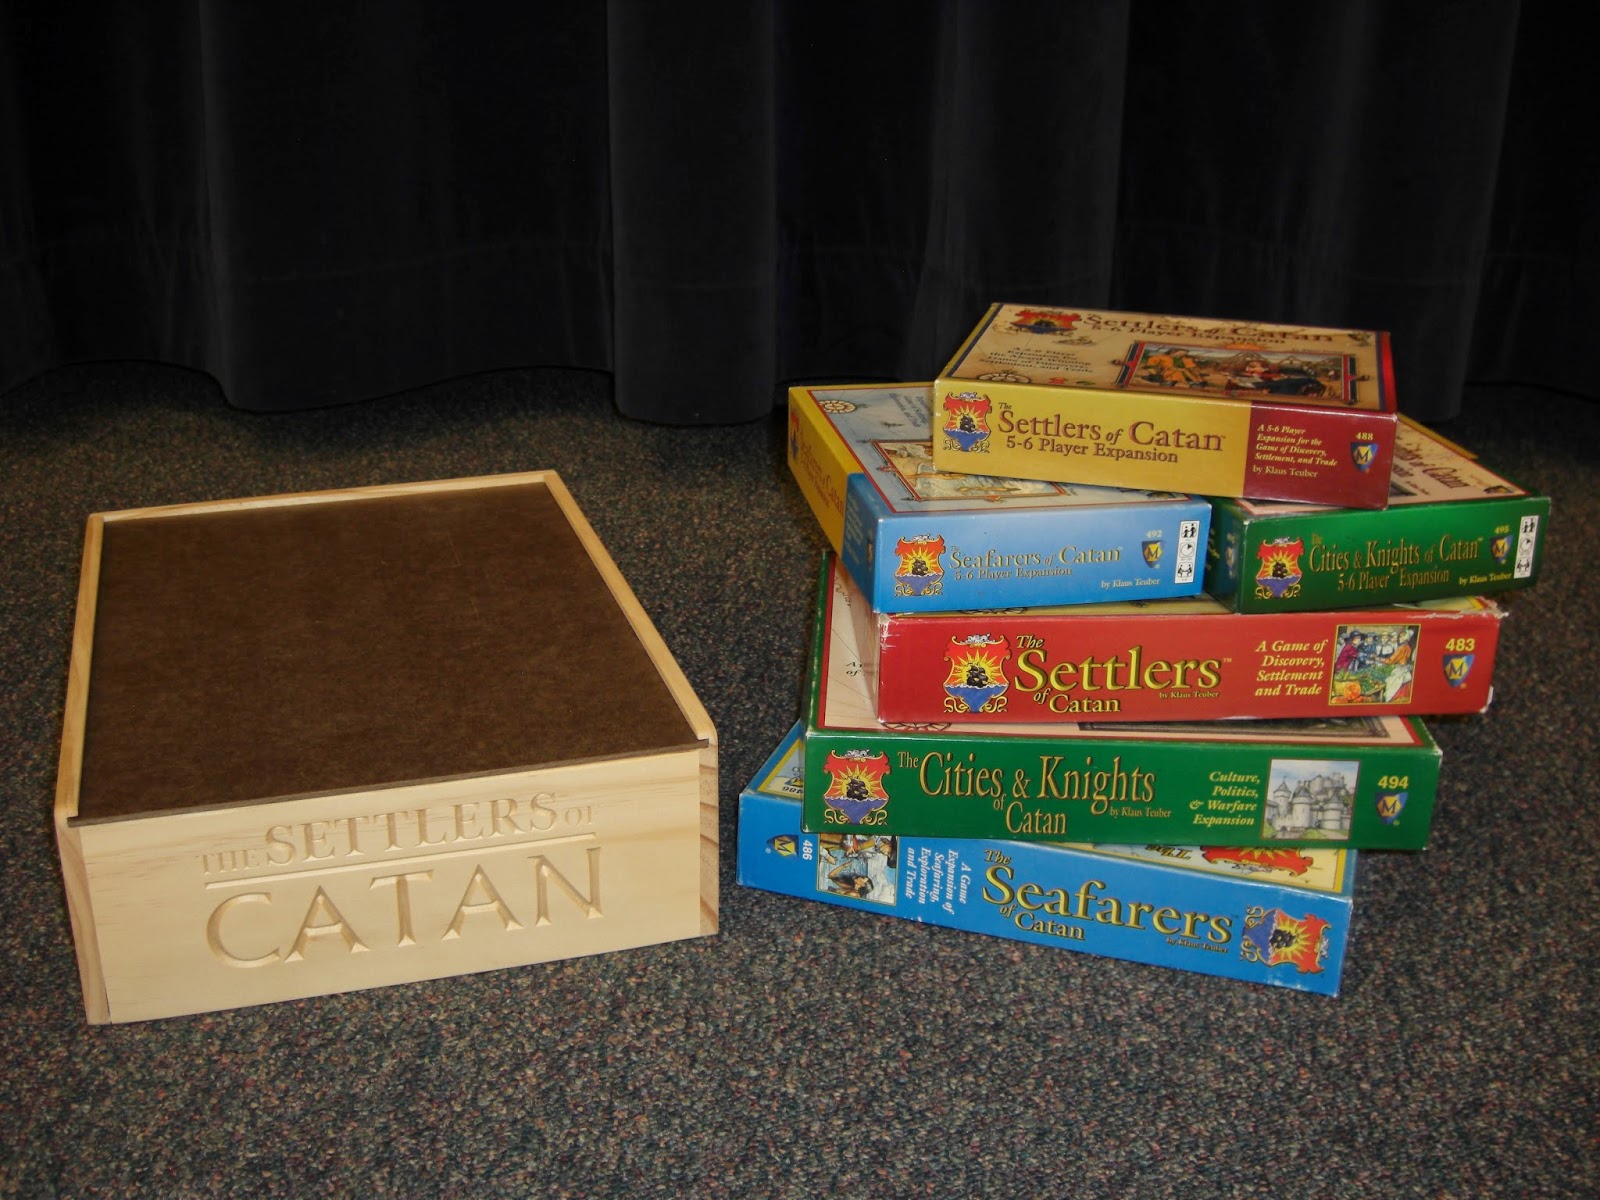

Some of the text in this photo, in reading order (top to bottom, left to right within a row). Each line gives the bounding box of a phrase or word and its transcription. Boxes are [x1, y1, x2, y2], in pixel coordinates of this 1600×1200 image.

[998, 402, 1012, 410] The
[998, 410, 1224, 451] Settlers of Catan
[1257, 424, 1306, 435] A 5-6 Player
[1355, 432, 1374, 440] 488
[1256, 433, 1322, 446] Expansion for the
[1006, 435, 1179, 463] 5-6 Player Expansion
[1256, 443, 1278, 452] Game
[1280, 444, 1288, 454] of
[1297, 456, 1313, 465] and
[1315, 458, 1338, 467] Trade
[1252, 465, 1318, 478] by Klaus Teuber
[949, 546, 1121, 570] Seafarers of Catan
[1309, 544, 1350, 573] Cities
[1353, 550, 1362, 567] &
[1365, 538, 1420, 574] Knights
[1439, 534, 1480, 561] Catan
[955, 566, 1072, 581] 5-6 Player Expansion
[1337, 567, 1449, 594] 5-6 Player Expansion
[1459, 576, 1468, 586] by
[1469, 574, 1488, 584] Klaus
[1101, 577, 1161, 589] by Klaus Teuber
[1016, 634, 1044, 649] The
[1255, 639, 1329, 654] A Game of
[1445, 638, 1476, 652] 483
[1014, 645, 1222, 692] Settlers
[1261, 655, 1325, 668] Discovery,
[1256, 669, 1323, 682] Settlement
[1159, 691, 1220, 699] by Klaus Teuber
[1254, 683, 1322, 697] and Trade
[1033, 688, 1121, 714] of Catan
[897, 751, 919, 770] The
[919, 751, 1157, 815] Cities & Knights
[1208, 770, 1261, 785] Culture,
[1378, 775, 1409, 789] 494
[1212, 785, 1259, 799] Politics,
[1109, 806, 1172, 819] by Klaus Teuber
[1207, 800, 1258, 812] Warfare
[993, 793, 1068, 836] of Catan
[1193, 813, 1255, 828] Expansion
[197, 847, 260, 874] THE
[264, 791, 558, 866] SETTLERS
[802, 839, 813, 861] 486
[984, 848, 1011, 865] The
[905, 847, 917, 900] and Trade
[918, 847, 932, 905] Exploration
[942, 849, 959, 915] Expansion of
[958, 862, 972, 905] A Game
[206, 846, 603, 968] CATAN
[982, 863, 1233, 944] Seafarers
[999, 902, 1086, 941] of Catan
[1166, 936, 1230, 953] by Klaus Teuber
